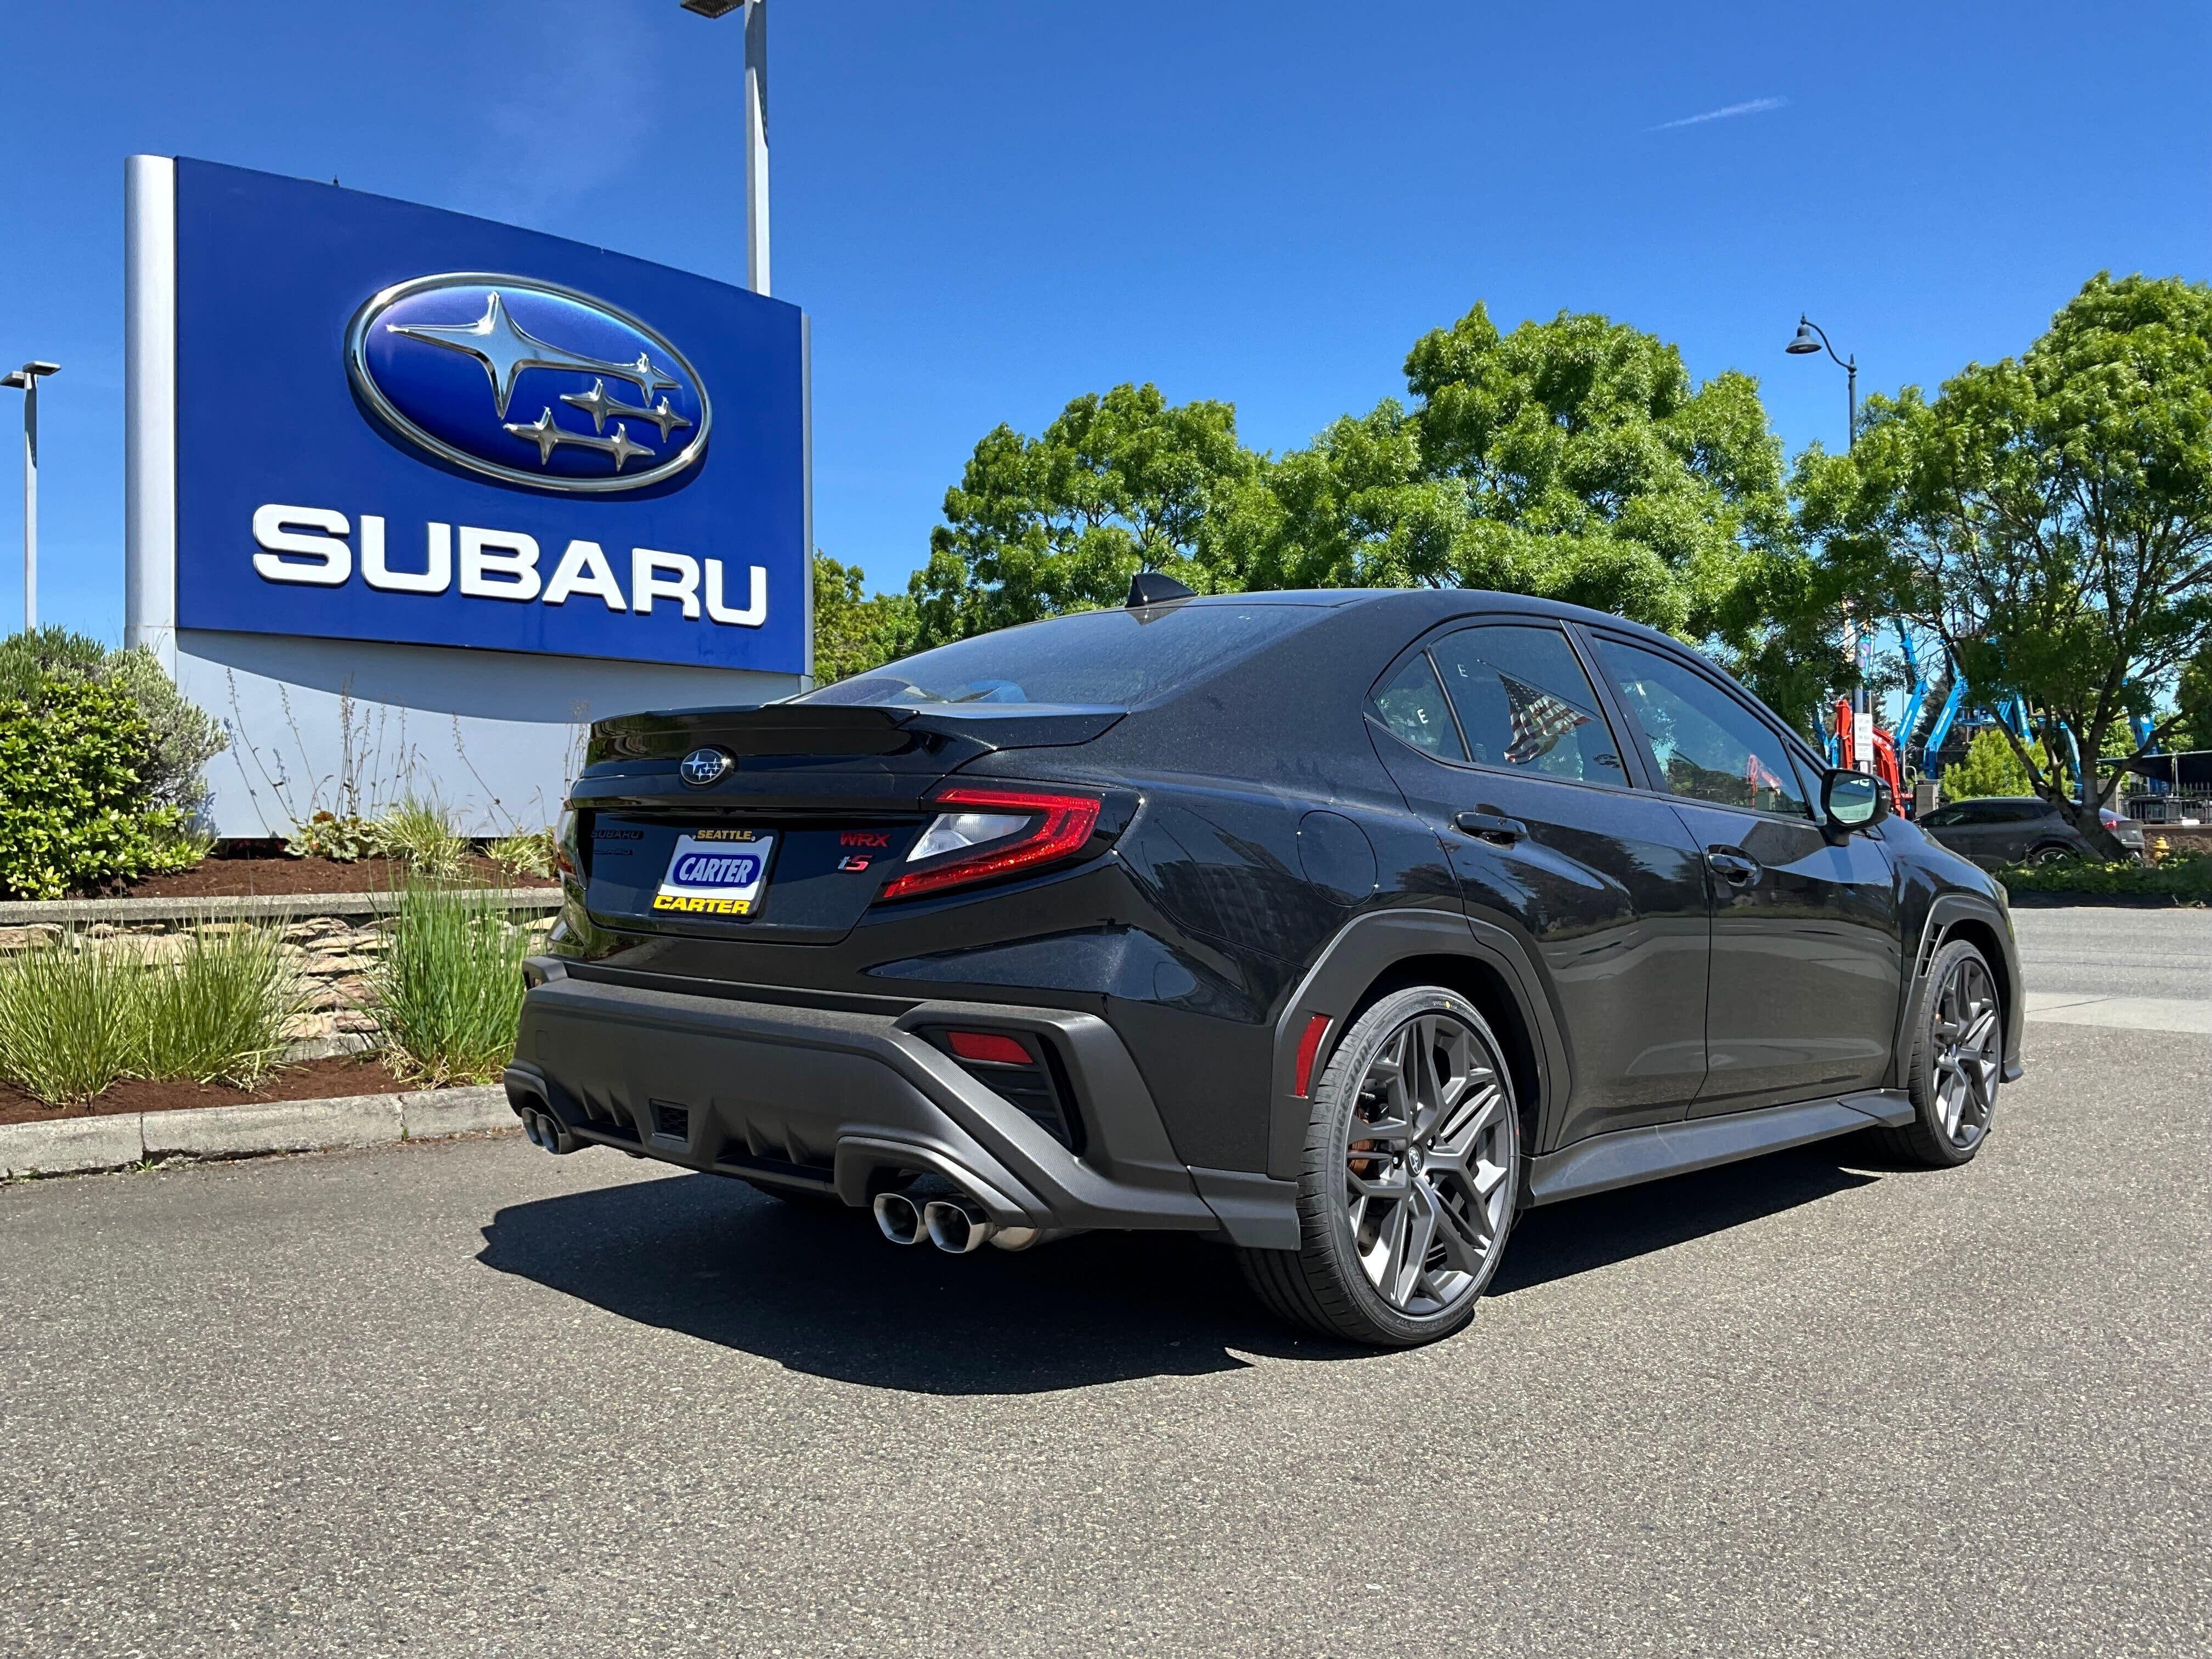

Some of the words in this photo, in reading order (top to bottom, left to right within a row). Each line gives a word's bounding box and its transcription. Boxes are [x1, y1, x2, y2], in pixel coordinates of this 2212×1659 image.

[252, 503, 767, 628] SUBARU
[590, 830, 641, 839] SUBARU
[697, 830, 752, 840] SEATTLE
[840, 832, 890, 848] WRX
[679, 857, 753, 883] CARTER
[653, 895, 751, 914] CARTER
